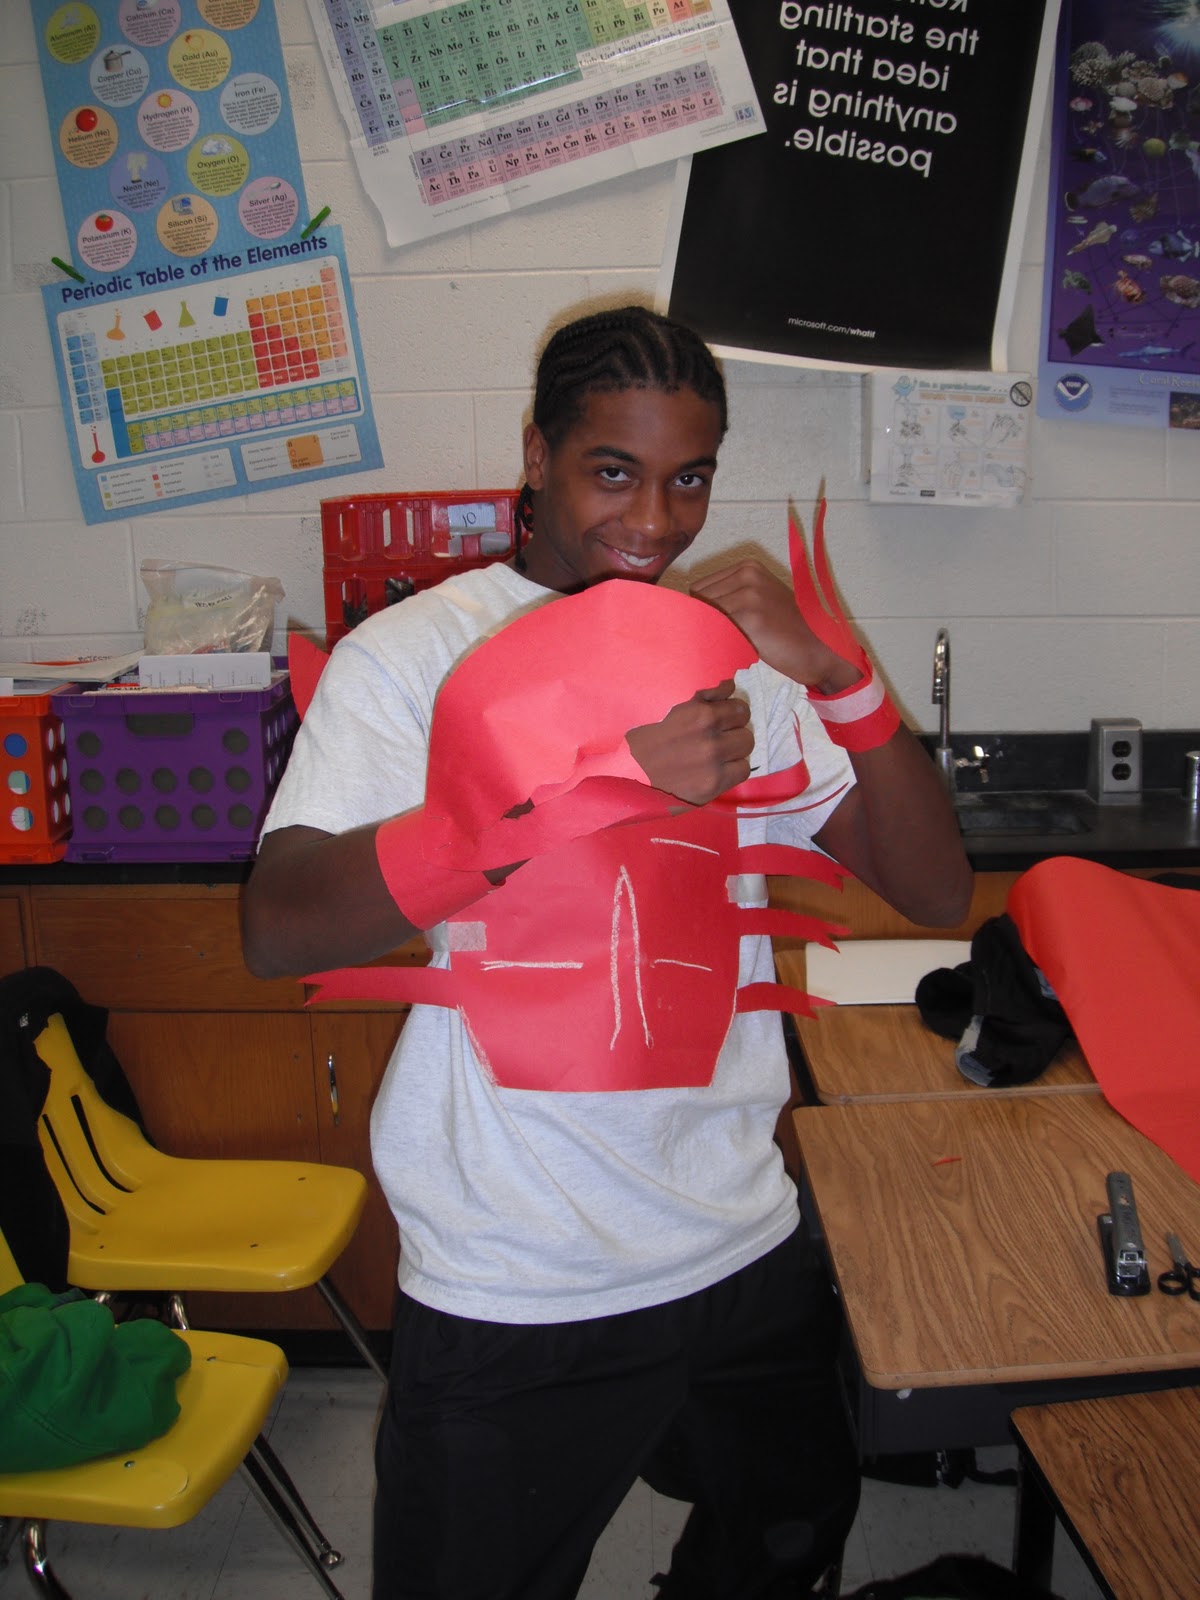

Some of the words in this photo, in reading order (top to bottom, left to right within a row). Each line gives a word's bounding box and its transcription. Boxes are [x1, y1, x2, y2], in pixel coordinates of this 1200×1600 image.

[480, 4, 491, 12] Fe
[565, 4, 579, 14] Cd
[673, 0, 685, 10] At
[458, 9, 474, 20] Mn
[547, 11, 560, 21] Ag
[653, 7, 665, 16] Po
[353, 14, 370, 24] Mg
[441, 16, 453, 24] Cr
[527, 17, 539, 26] Pd
[634, 12, 644, 22] Bi
[335, 22, 349, 30] Na
[613, 18, 625, 28] Pb
[402, 28, 413, 36] Ti
[507, 23, 520, 33] Rh
[594, 25, 605, 34] Tl
[487, 30, 501, 38] Ru
[383, 35, 394, 43] Sc
[468, 36, 480, 44] Tc
[555, 38, 568, 47] Au
[362, 41, 376, 50] Ca
[447, 43, 463, 52] Mo
[536, 44, 547, 52] Pt
[182, 53, 200, 61] Gold
[202, 50, 218, 59] (Au)
[428, 49, 443, 58] Nb
[517, 50, 526, 58] Ir
[410, 55, 422, 64] Zr
[495, 57, 508, 65] Os
[476, 62, 489, 71] Re
[97, 72, 123, 83] Copper
[126, 68, 141, 77] (Cu)
[372, 68, 382, 76] Sr
[694, 70, 707, 79] Lu
[351, 73, 364, 82] Rb
[673, 76, 687, 86] Yb
[418, 80, 430, 90] Hf
[652, 82, 669, 91] Tm
[235, 90, 250, 98] Iron
[252, 86, 266, 95] (Fe)
[635, 88, 647, 97] Er
[379, 94, 391, 102] Ba
[614, 95, 628, 104] Ho
[703, 97, 714, 106] Lr
[360, 100, 372, 108] Cs
[595, 101, 608, 111] Dy
[682, 103, 696, 112] No
[143, 109, 179, 122] Hydrogen
[181, 106, 193, 114] (H)
[576, 107, 589, 116] Tb
[661, 108, 677, 119] Md
[556, 113, 570, 122] Gd
[642, 114, 657, 124] Fm
[387, 120, 400, 129] Ra
[537, 120, 550, 129] Eu
[624, 121, 635, 129] Es
[369, 126, 379, 134] Fr
[516, 126, 531, 135] Sm
[604, 126, 616, 136] Cf
[497, 132, 512, 141] Pm
[584, 133, 597, 143] Bk
[478, 138, 492, 147] Nd
[563, 139, 579, 149] Cm
[460, 145, 471, 153] Pr
[544, 145, 560, 156] Am
[440, 151, 452, 159] Ce
[525, 152, 538, 161] Pu
[197, 159, 225, 168] Oxygen
[227, 155, 240, 164] (O)
[421, 157, 432, 165] La
[505, 158, 519, 167] Np
[468, 171, 480, 179] Pa
[447, 177, 460, 185] Th
[123, 184, 142, 193] Neon
[144, 180, 160, 188] (Ne)
[429, 184, 441, 192] Ac
[249, 198, 270, 207] Silver
[272, 193, 287, 203] (Ag)
[167, 218, 193, 228] Silicon
[194, 215, 208, 224] (Si)
[82, 231, 120, 243] Potassium
[121, 227, 131, 236] (K)
[61, 276, 132, 303] Periodic
[137, 266, 187, 288] Table
[190, 260, 208, 277] of
[211, 255, 242, 273] the
[248, 236, 328, 265] Elements
[788, 317, 876, 338] microsoft.com/whatif
[462, 512, 477, 528] 10
